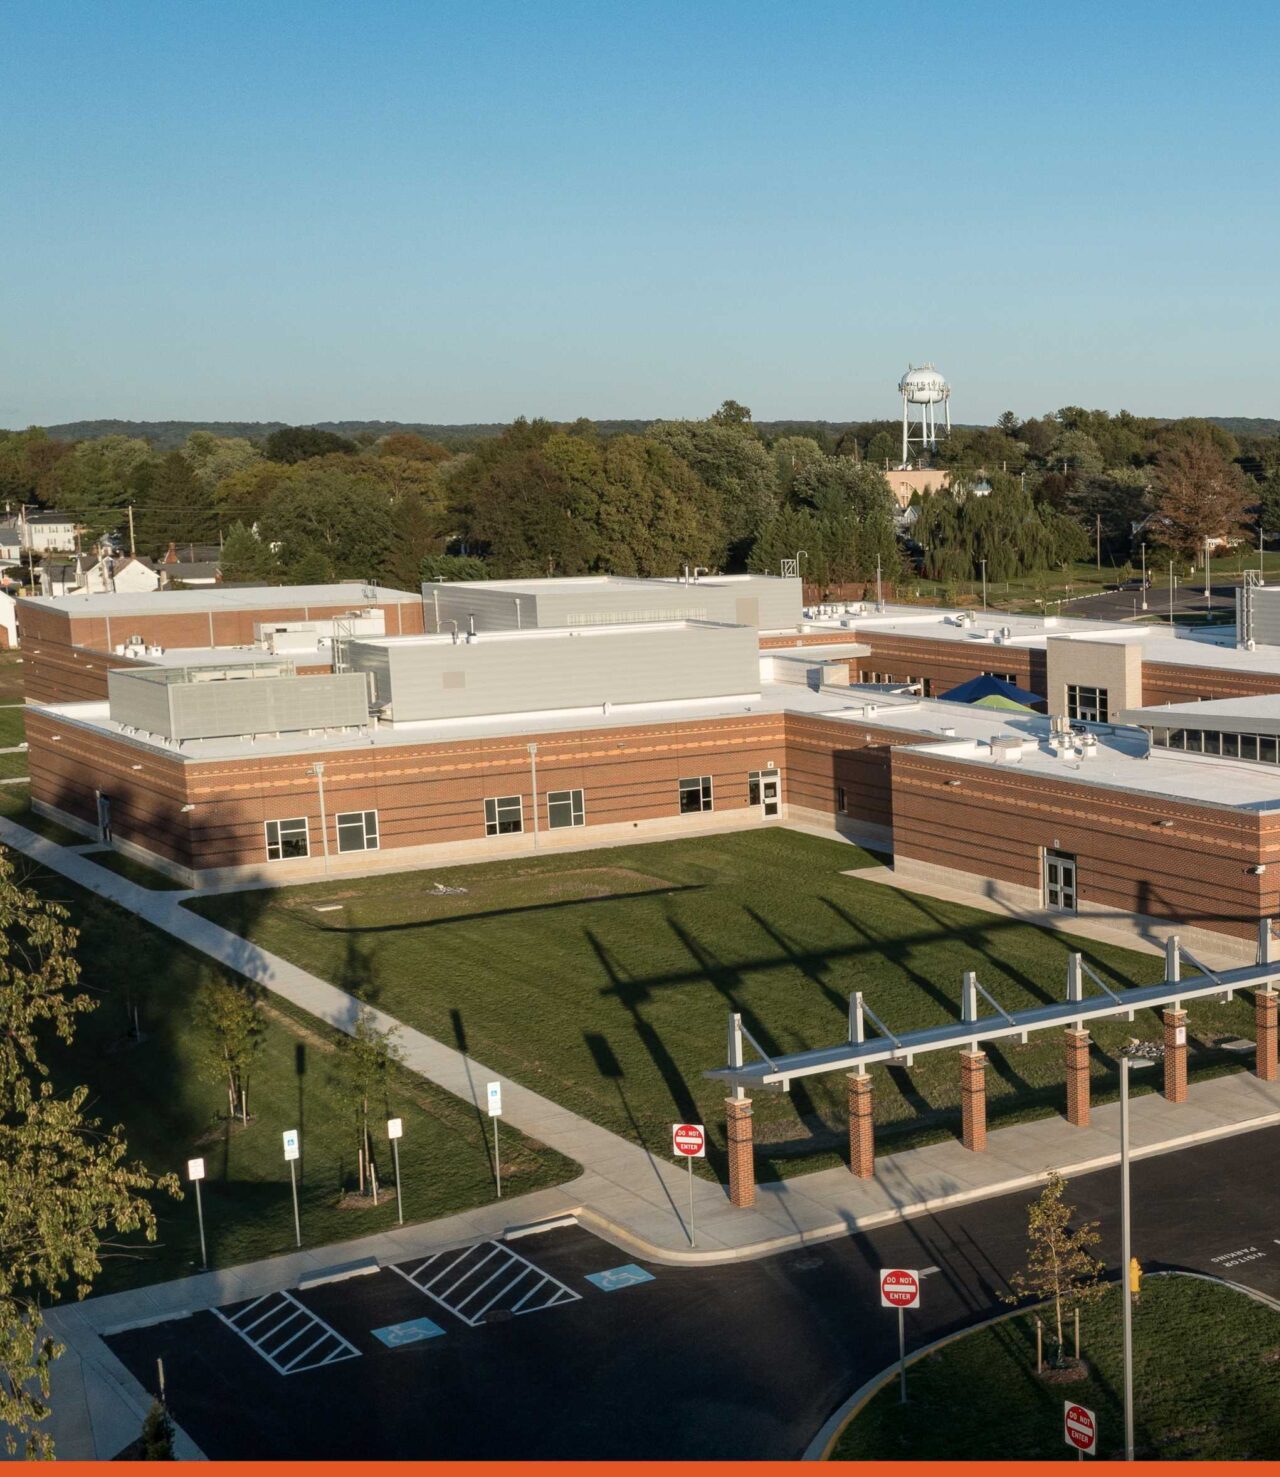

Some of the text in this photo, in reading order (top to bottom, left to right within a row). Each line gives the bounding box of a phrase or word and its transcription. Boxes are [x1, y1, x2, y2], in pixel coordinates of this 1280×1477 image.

[1210, 1246, 1258, 1263] PARKING
[1222, 1252, 1267, 1268] VISITOR
[1069, 1411, 1090, 1426] DO NOT
[1071, 1430, 1089, 1443] ENTER
